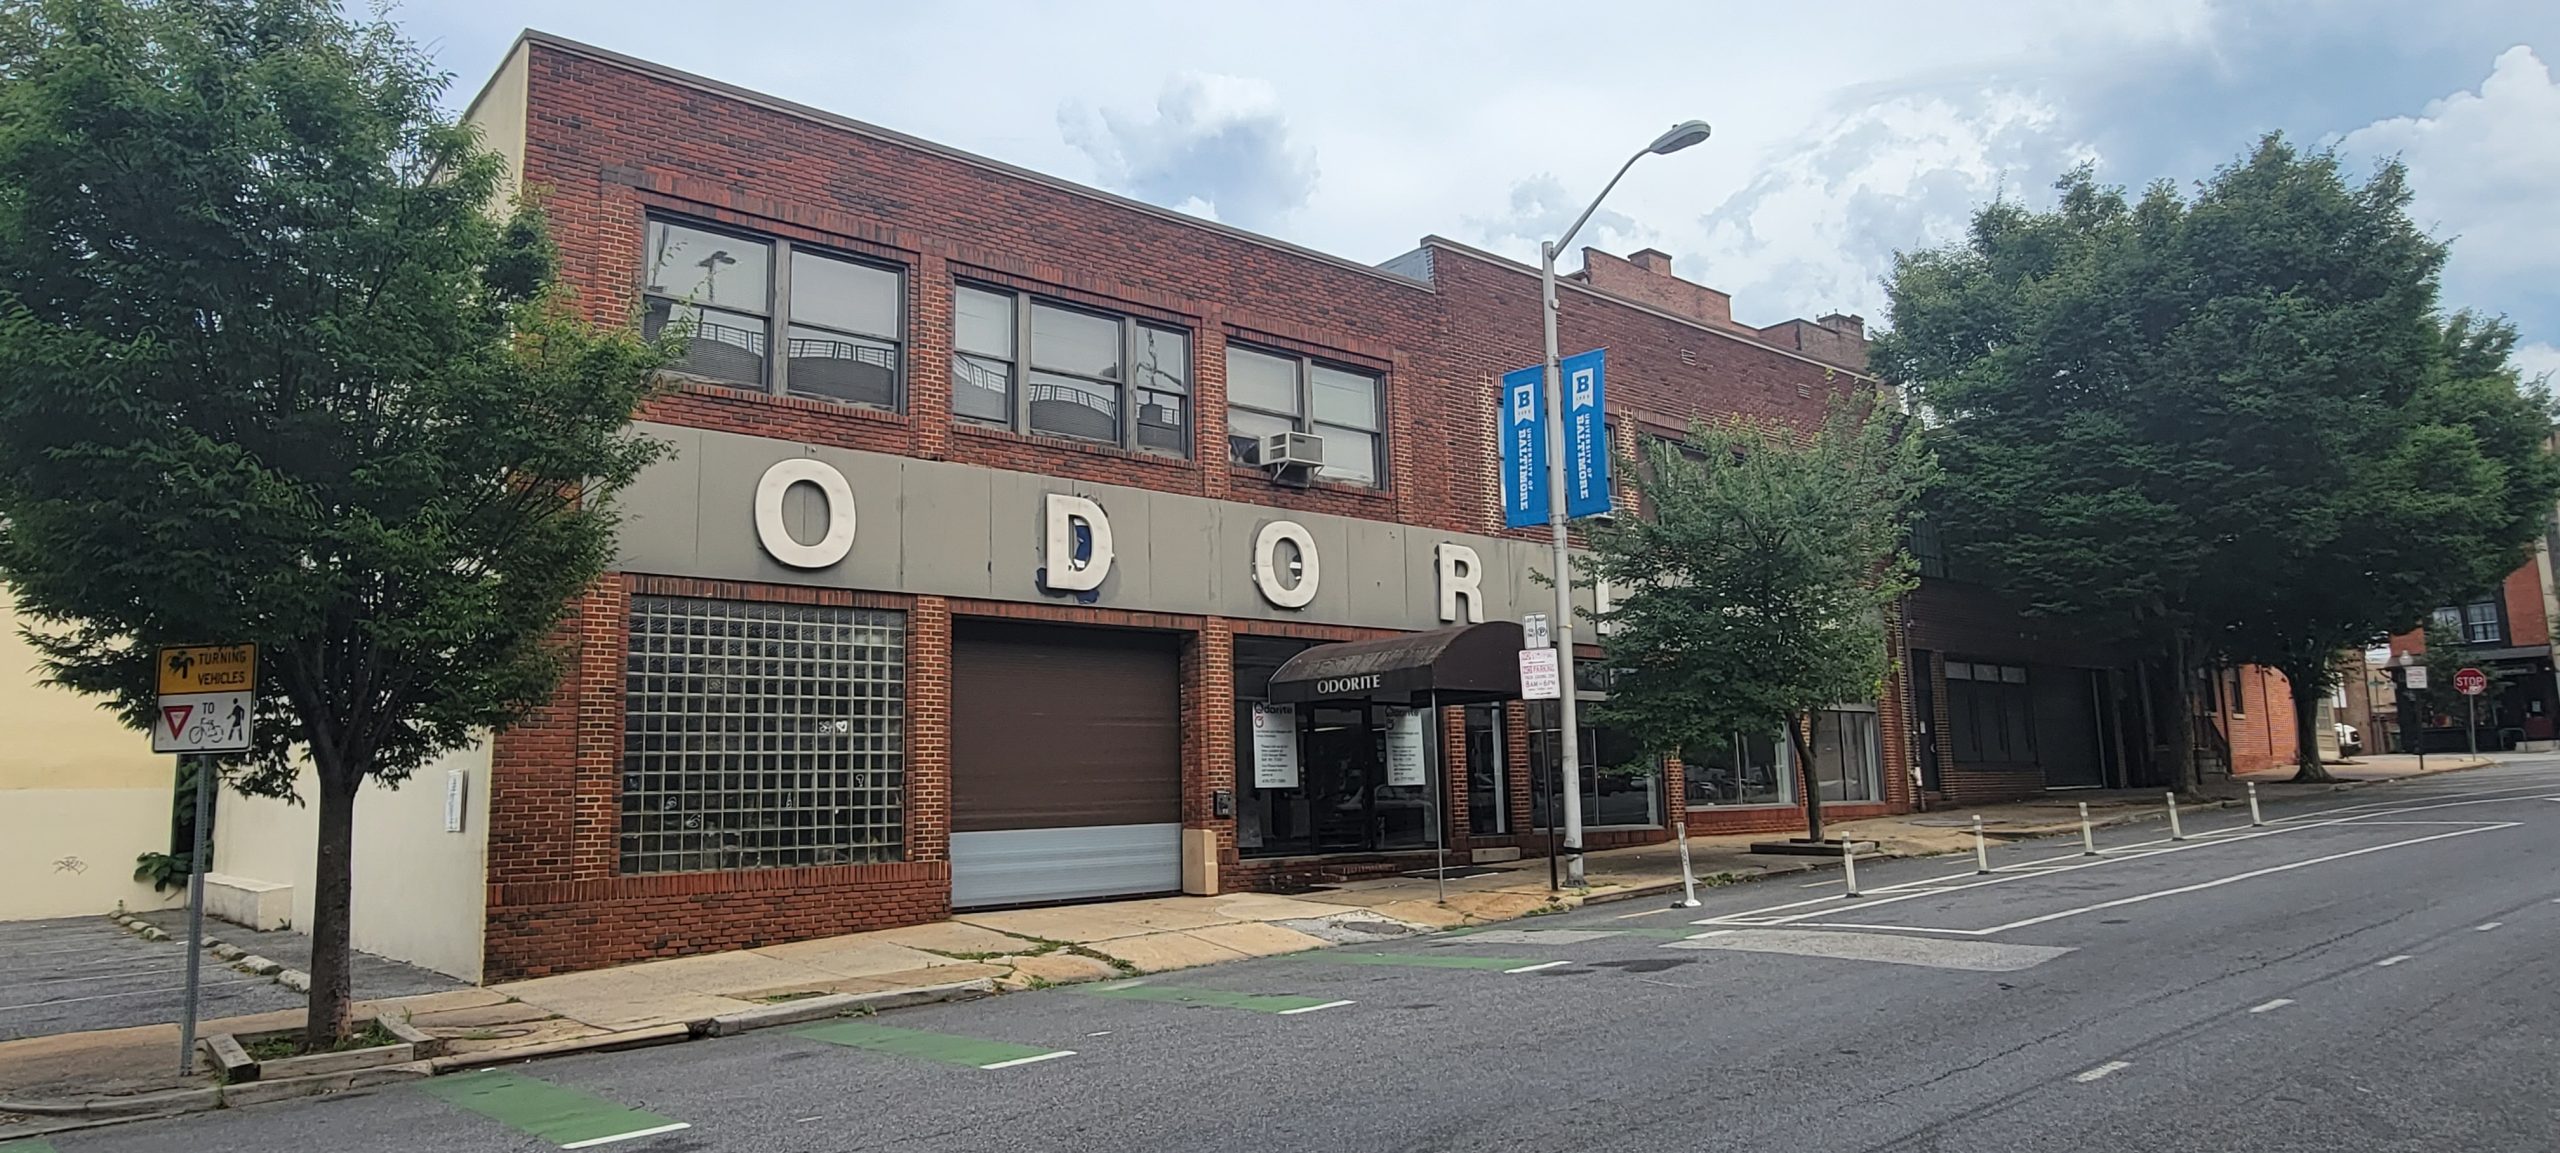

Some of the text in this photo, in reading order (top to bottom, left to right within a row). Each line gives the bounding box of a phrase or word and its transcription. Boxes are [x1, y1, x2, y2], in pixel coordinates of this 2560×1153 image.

[1576, 375, 1589, 394] B
[1517, 391, 1530, 409] B
[1576, 414, 1589, 500] BALTIMORE
[1518, 429, 1529, 511] BALTIMORE
[198, 650, 247, 665] TURNING
[198, 670, 246, 686] VEHICLES
[1317, 674, 1381, 694] ODORITE
[2456, 676, 2483, 687] STOP
[202, 702, 215, 714] TO
